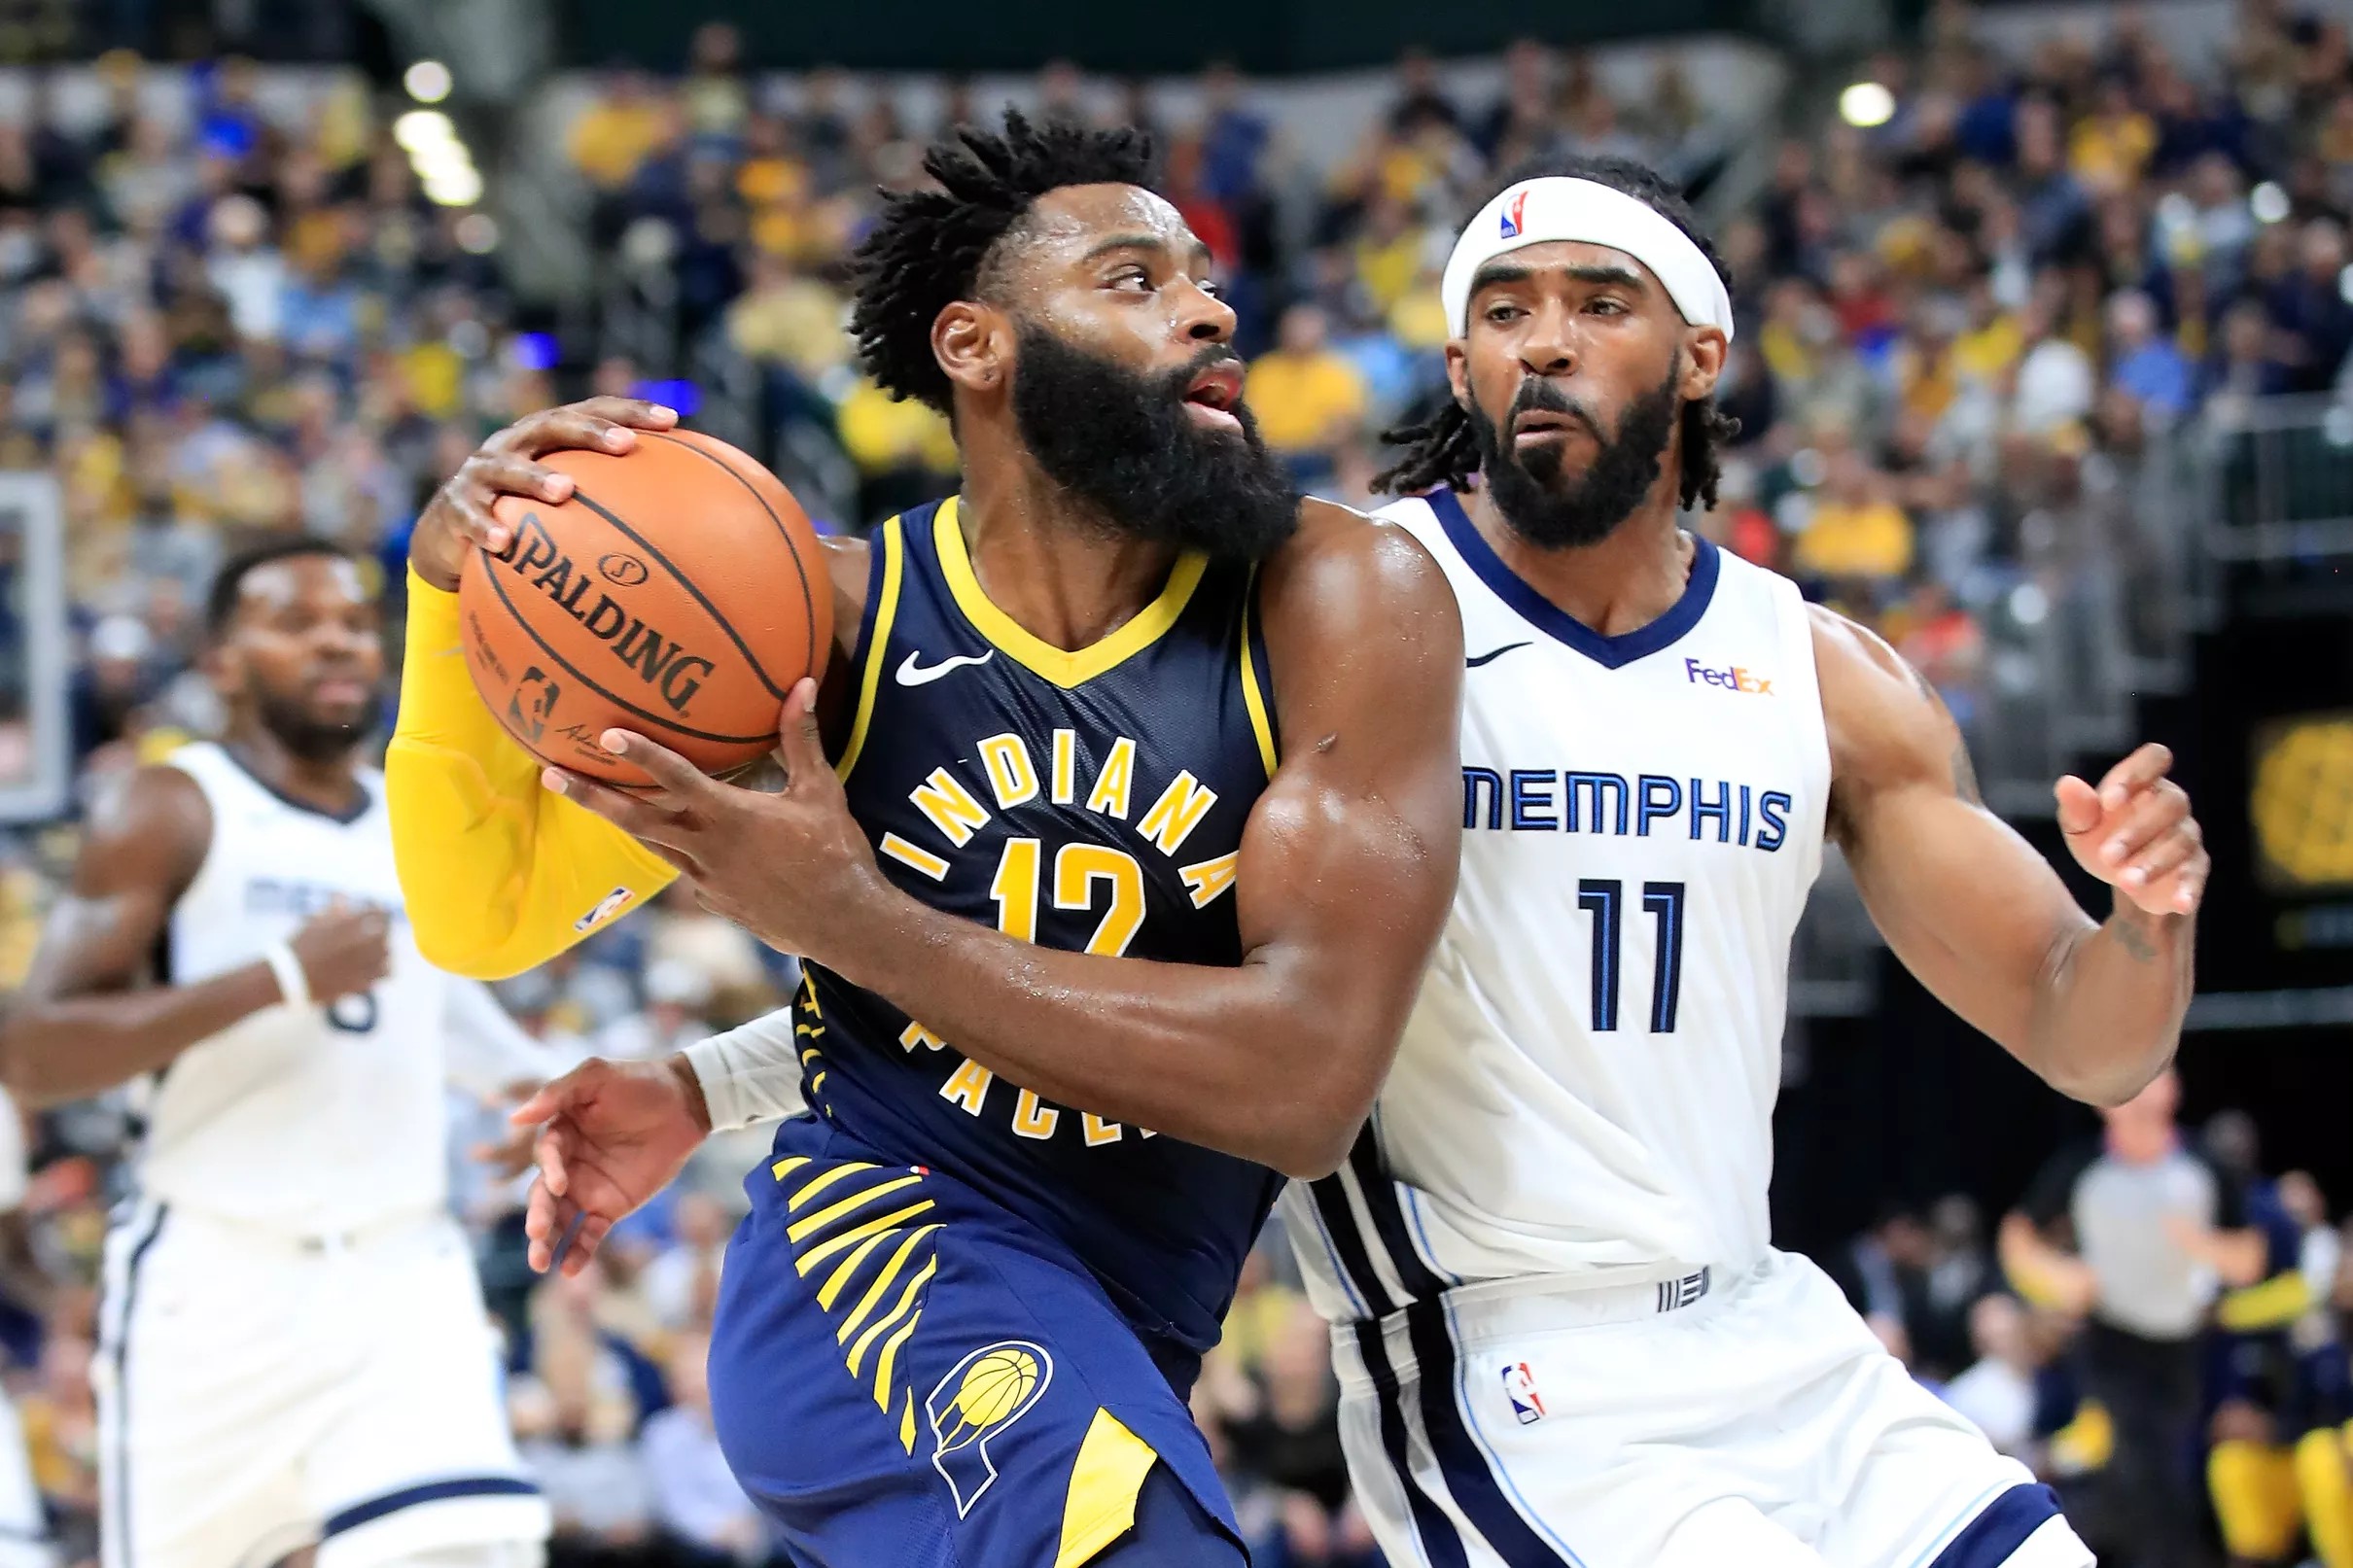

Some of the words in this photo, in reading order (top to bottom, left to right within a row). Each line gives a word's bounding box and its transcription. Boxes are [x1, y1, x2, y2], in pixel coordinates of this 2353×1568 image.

[494, 512, 716, 713] SPALDING
[1685, 657, 1774, 696] FedEx
[879, 728, 1240, 910] INDIANA
[1462, 766, 1792, 853] MEMPHIS
[990, 837, 1146, 958] 12
[1578, 879, 1685, 1033] 11
